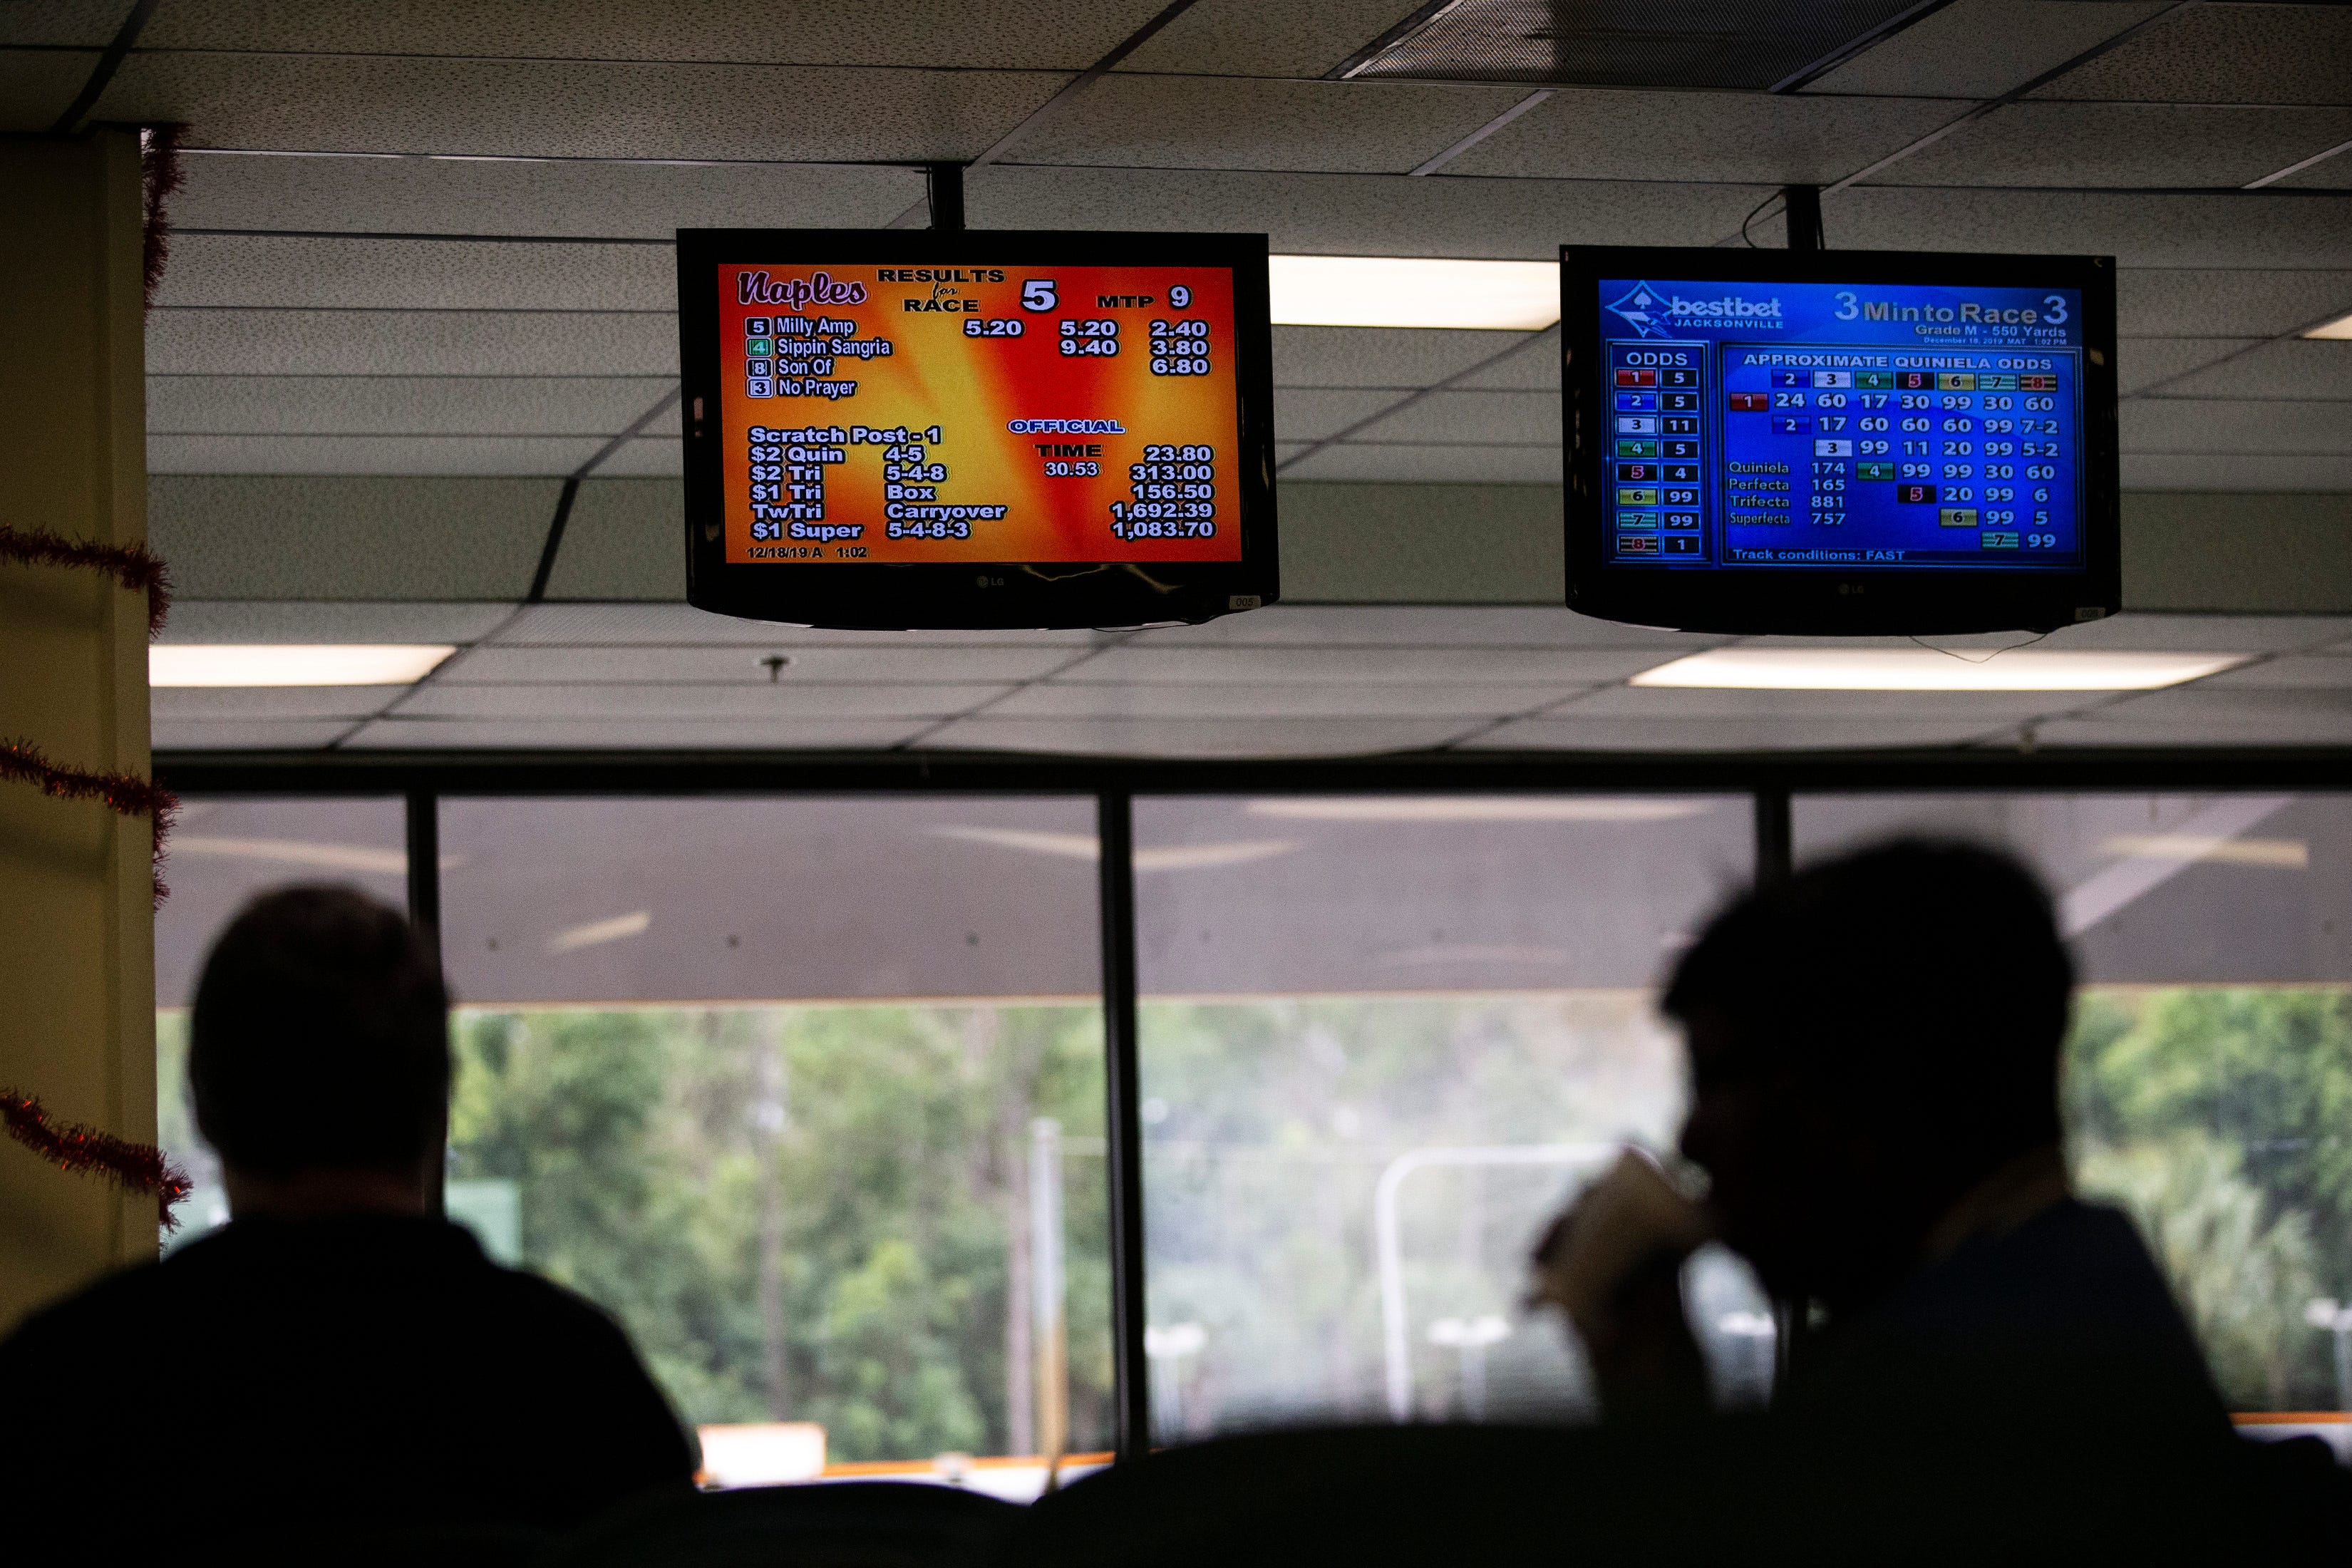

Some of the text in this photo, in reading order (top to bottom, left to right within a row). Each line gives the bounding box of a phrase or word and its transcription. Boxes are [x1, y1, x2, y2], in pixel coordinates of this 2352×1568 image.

[877, 269, 1006, 282] RESULTS
[738, 271, 868, 311] Naples
[932, 282, 958, 299] for
[1023, 281, 1056, 311] 5
[1098, 287, 1189, 308] MTP 9
[903, 299, 980, 312] RACE
[1672, 296, 1781, 316] bestbet
[1835, 292, 1859, 320] 3
[1960, 303, 2037, 324] Race
[2043, 296, 2067, 324] 3
[753, 318, 1206, 336] 5 Milly Amp 5.20 5.20 2.40
[1675, 319, 1783, 329] JACKSONVILLE
[1916, 325, 1960, 335] Grade
[1965, 326, 1977, 335] M
[1992, 326, 2018, 336] 550
[2023, 326, 2066, 337] Yards
[753, 339, 1207, 358] 4 Sippin Sangria 9.40 3.80
[1626, 352, 1688, 366] ODDS
[1743, 354, 2052, 371] APPROXIMATE QUINIELA ODDS
[755, 359, 1207, 374] 8 Son Of 6.80
[1631, 371, 1684, 383] 1 5
[1785, 373, 2044, 389] 2 3 4 5 6 7 8
[755, 380, 855, 398] 3 No Prayer
[1631, 396, 1684, 407] 2 5
[1745, 393, 2054, 411] 1 24 60 17 30 99 30 60
[1008, 420, 1125, 433] OFFICIAL
[1632, 420, 1689, 430] 3 11
[1786, 417, 2058, 434] 2 17 60 60 60 99 7-2
[751, 428, 845, 443] Scratch
[853, 428, 907, 443] Post
[927, 428, 939, 443] 1
[751, 446, 1210, 463] $2 Quin 4-5 23.80
[1035, 445, 1103, 457] TIME
[1632, 443, 1685, 455] 4 5
[1828, 440, 2058, 457] 3 99 11 20 99 5-2
[752, 465, 1211, 482] $2 Tri 5-4-8 313.00
[1046, 463, 1098, 475] 30.53
[1631, 466, 1686, 478] 5 4
[1729, 462, 1845, 474] Quiniela 174
[1869, 464, 2055, 479] 4 99 99 30 60
[1729, 479, 1845, 490] Perfecta 165
[753, 484, 1212, 500] $1 Tri Box 156.50
[1632, 491, 1692, 502] 6 99
[1910, 487, 2048, 502] 5 20 99 6
[1731, 495, 1843, 507] Trifecta 881
[753, 503, 1212, 521] TwTri Carryover 1,692.39
[1731, 512, 1846, 525] Superfecta 757
[1953, 511, 2048, 525] 6 99 5
[1634, 514, 1692, 525] 7 99
[753, 522, 1212, 541] $1 Super 5-4-8-3 1,083.70
[1631, 538, 1685, 550] 8 1
[1995, 535, 2056, 547] 7 99
[747, 547, 867, 557] 12/18/19 A 1:02
[1733, 550, 1904, 560] Track conditions: FAST
